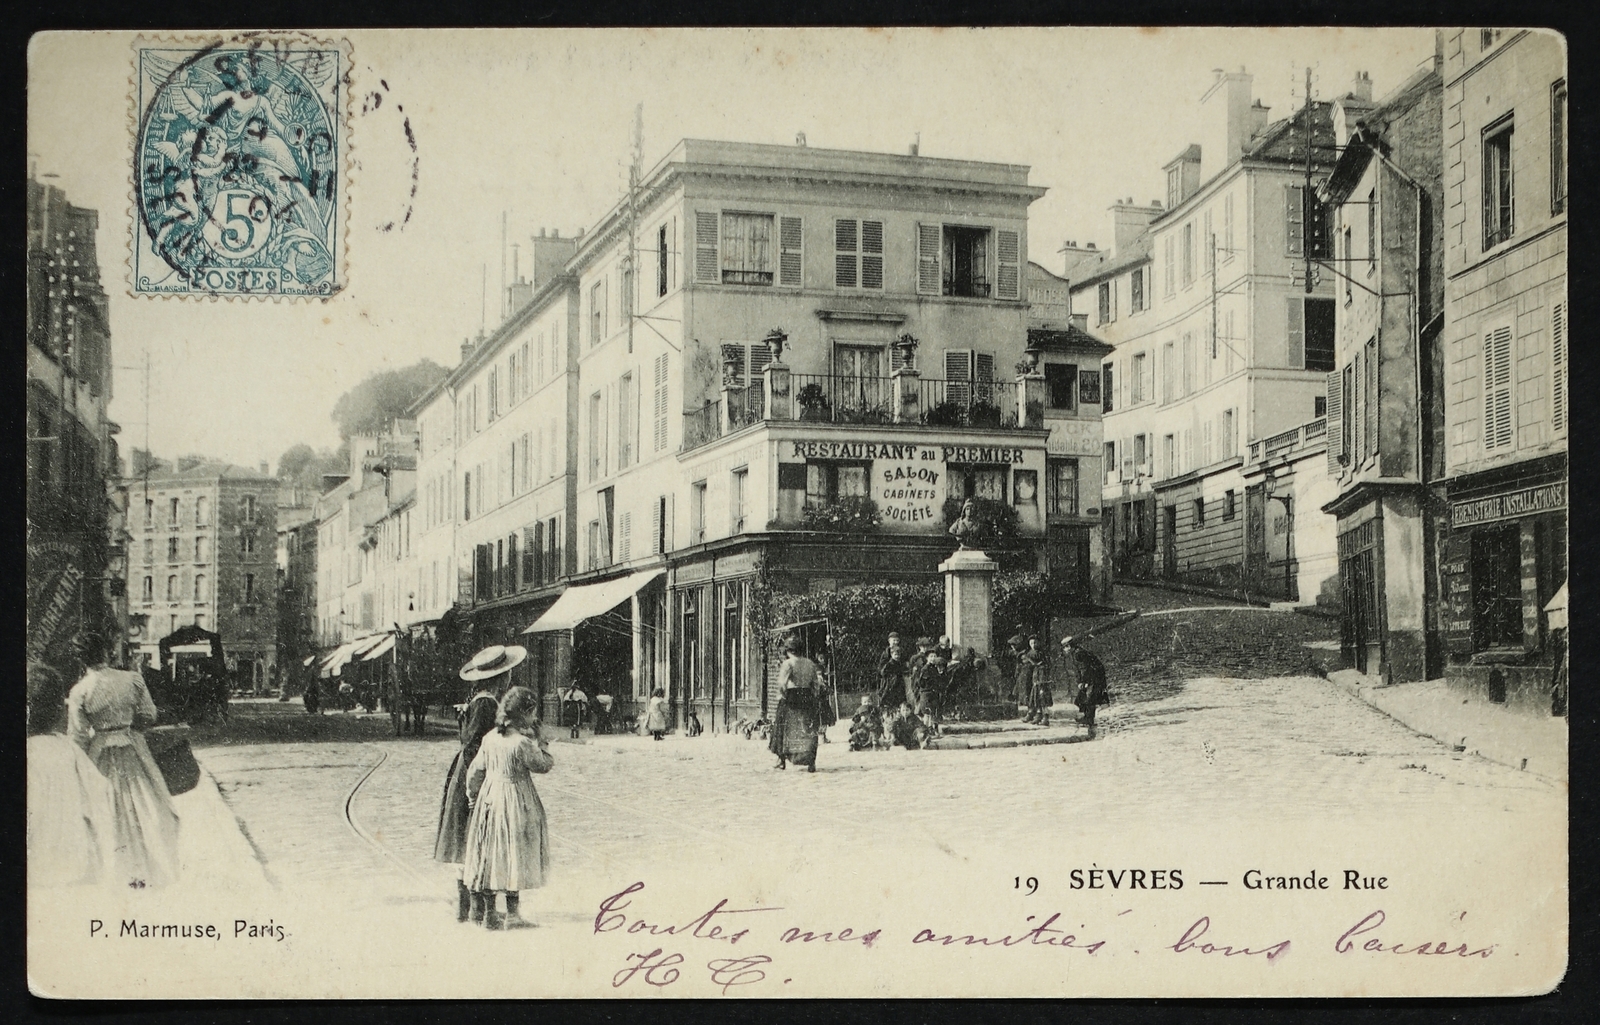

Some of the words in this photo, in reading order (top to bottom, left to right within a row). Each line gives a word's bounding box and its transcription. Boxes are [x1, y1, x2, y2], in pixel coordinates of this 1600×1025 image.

[220, 193, 255, 253] 5
[192, 270, 278, 294] POSTES
[792, 441, 917, 461] RESTAURANT
[921, 450, 936, 461] au
[941, 446, 1025, 464] PREMIER
[883, 465, 940, 486] SALON
[883, 488, 936, 500] CABINETS
[1503, 485, 1563, 515] INSTALLATIONS
[594, 881, 785, 945] Toutes
[779, 927, 882, 948] mes
